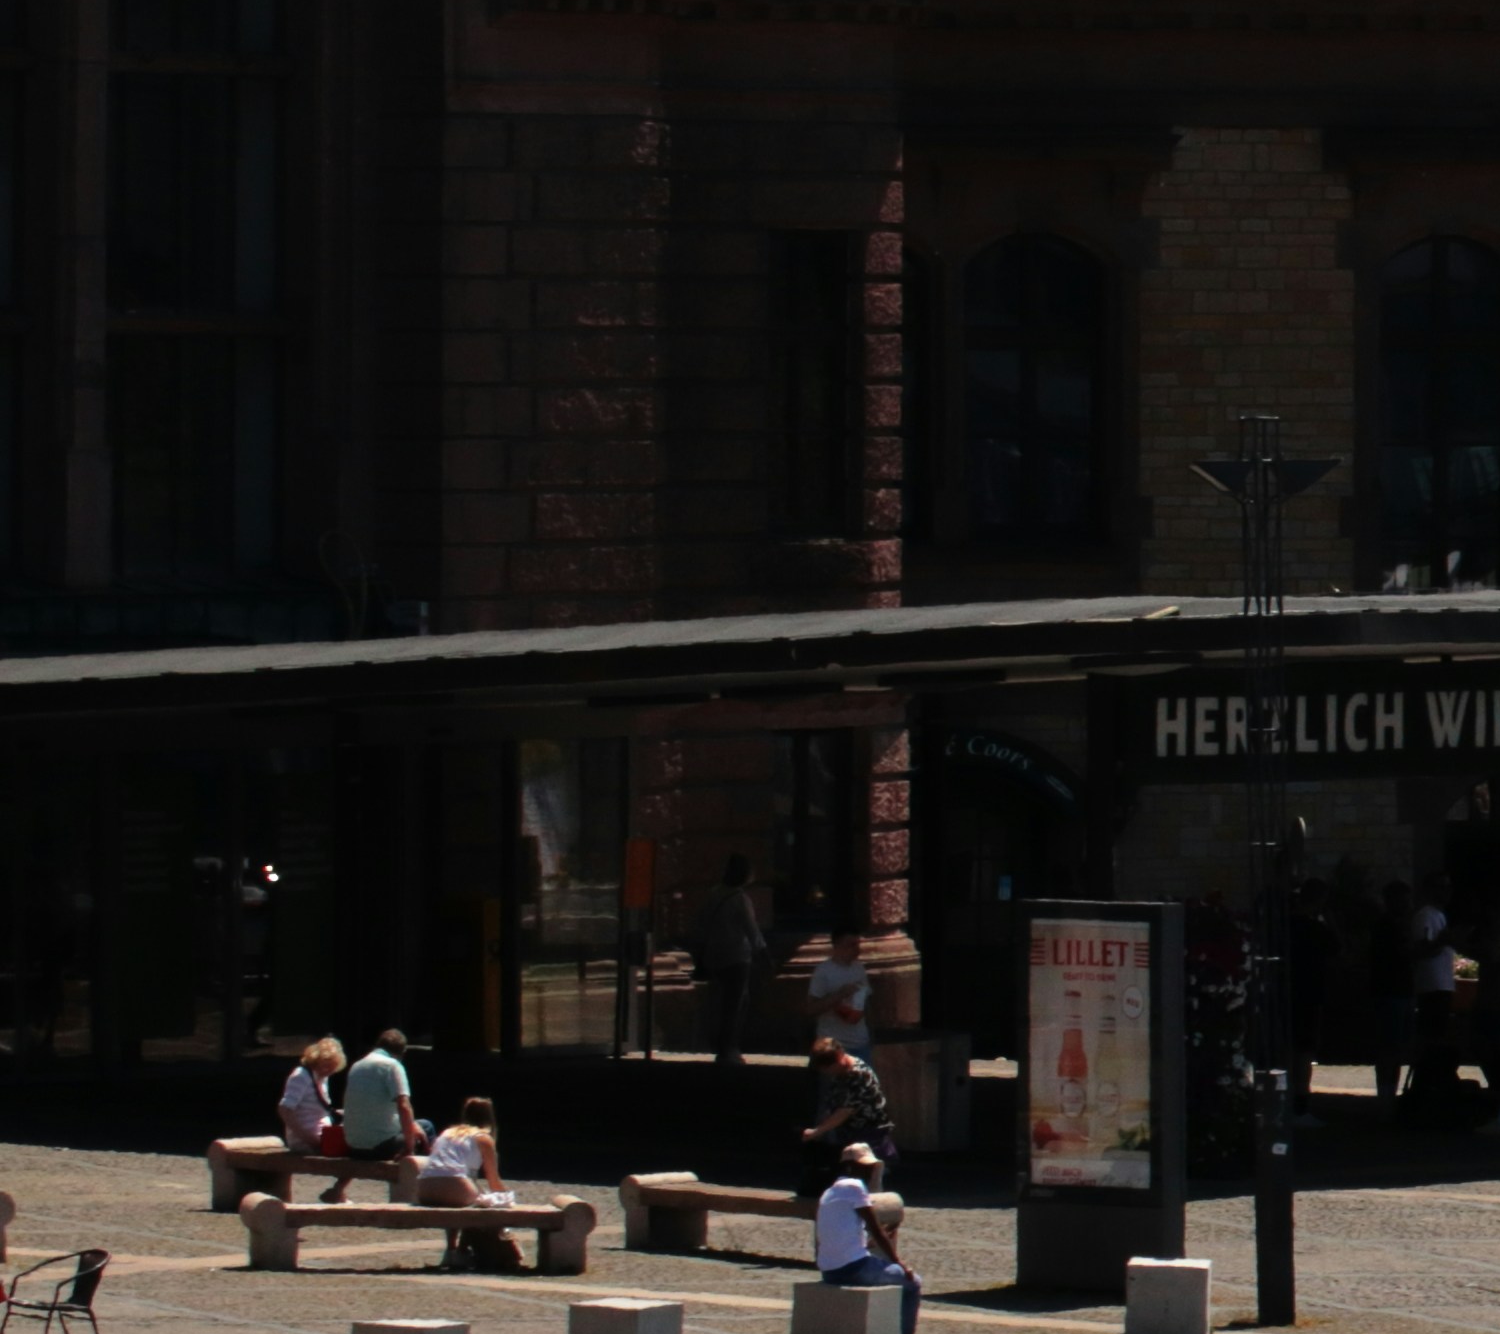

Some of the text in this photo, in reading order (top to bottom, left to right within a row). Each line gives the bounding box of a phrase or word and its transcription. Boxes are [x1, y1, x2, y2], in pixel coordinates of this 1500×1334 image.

[1155, 691, 1405, 758] HERZLICH
[966, 735, 1034, 771] Coors
[1052, 938, 1130, 968] LILLET
